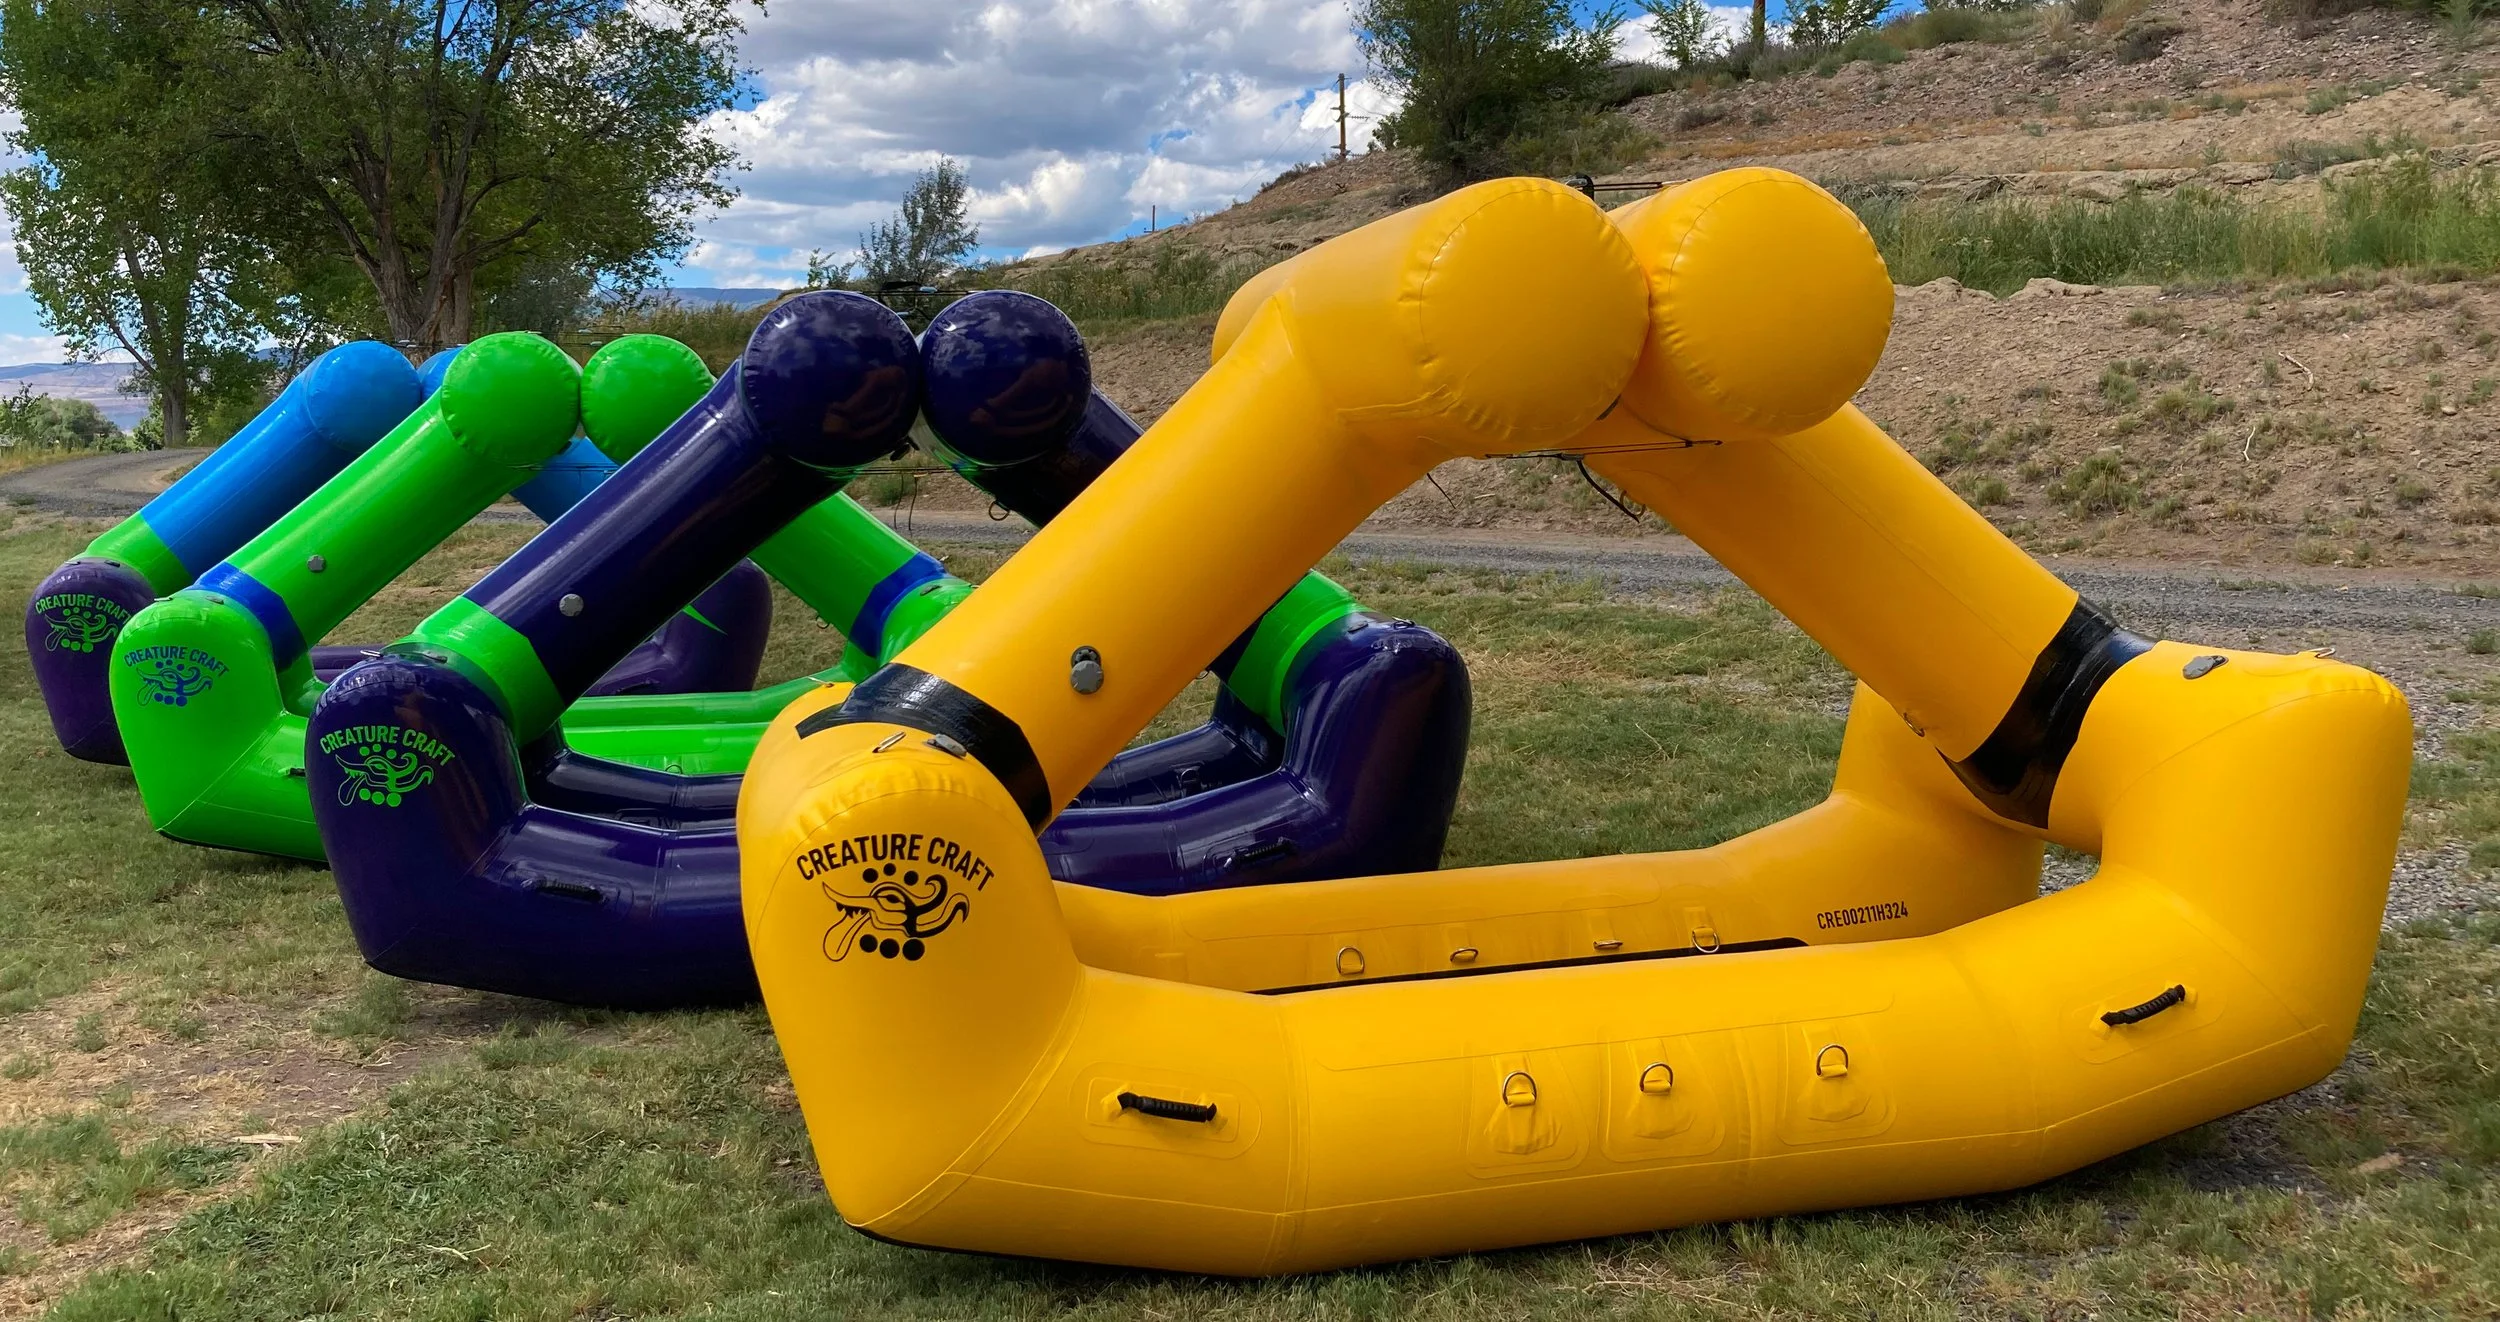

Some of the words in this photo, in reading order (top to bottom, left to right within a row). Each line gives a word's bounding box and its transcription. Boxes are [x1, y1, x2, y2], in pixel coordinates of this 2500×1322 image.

[35, 593, 95, 614] CREATURE
[124, 645, 187, 667] CREATURE
[189, 649, 229, 677] CRAFT
[319, 725, 400, 754] CREATURE
[402, 729, 455, 766] CRAFT
[797, 833, 923, 880] CREATURE
[927, 837, 994, 891] CRAFT
[1817, 901, 1908, 929] CRE00211H324
